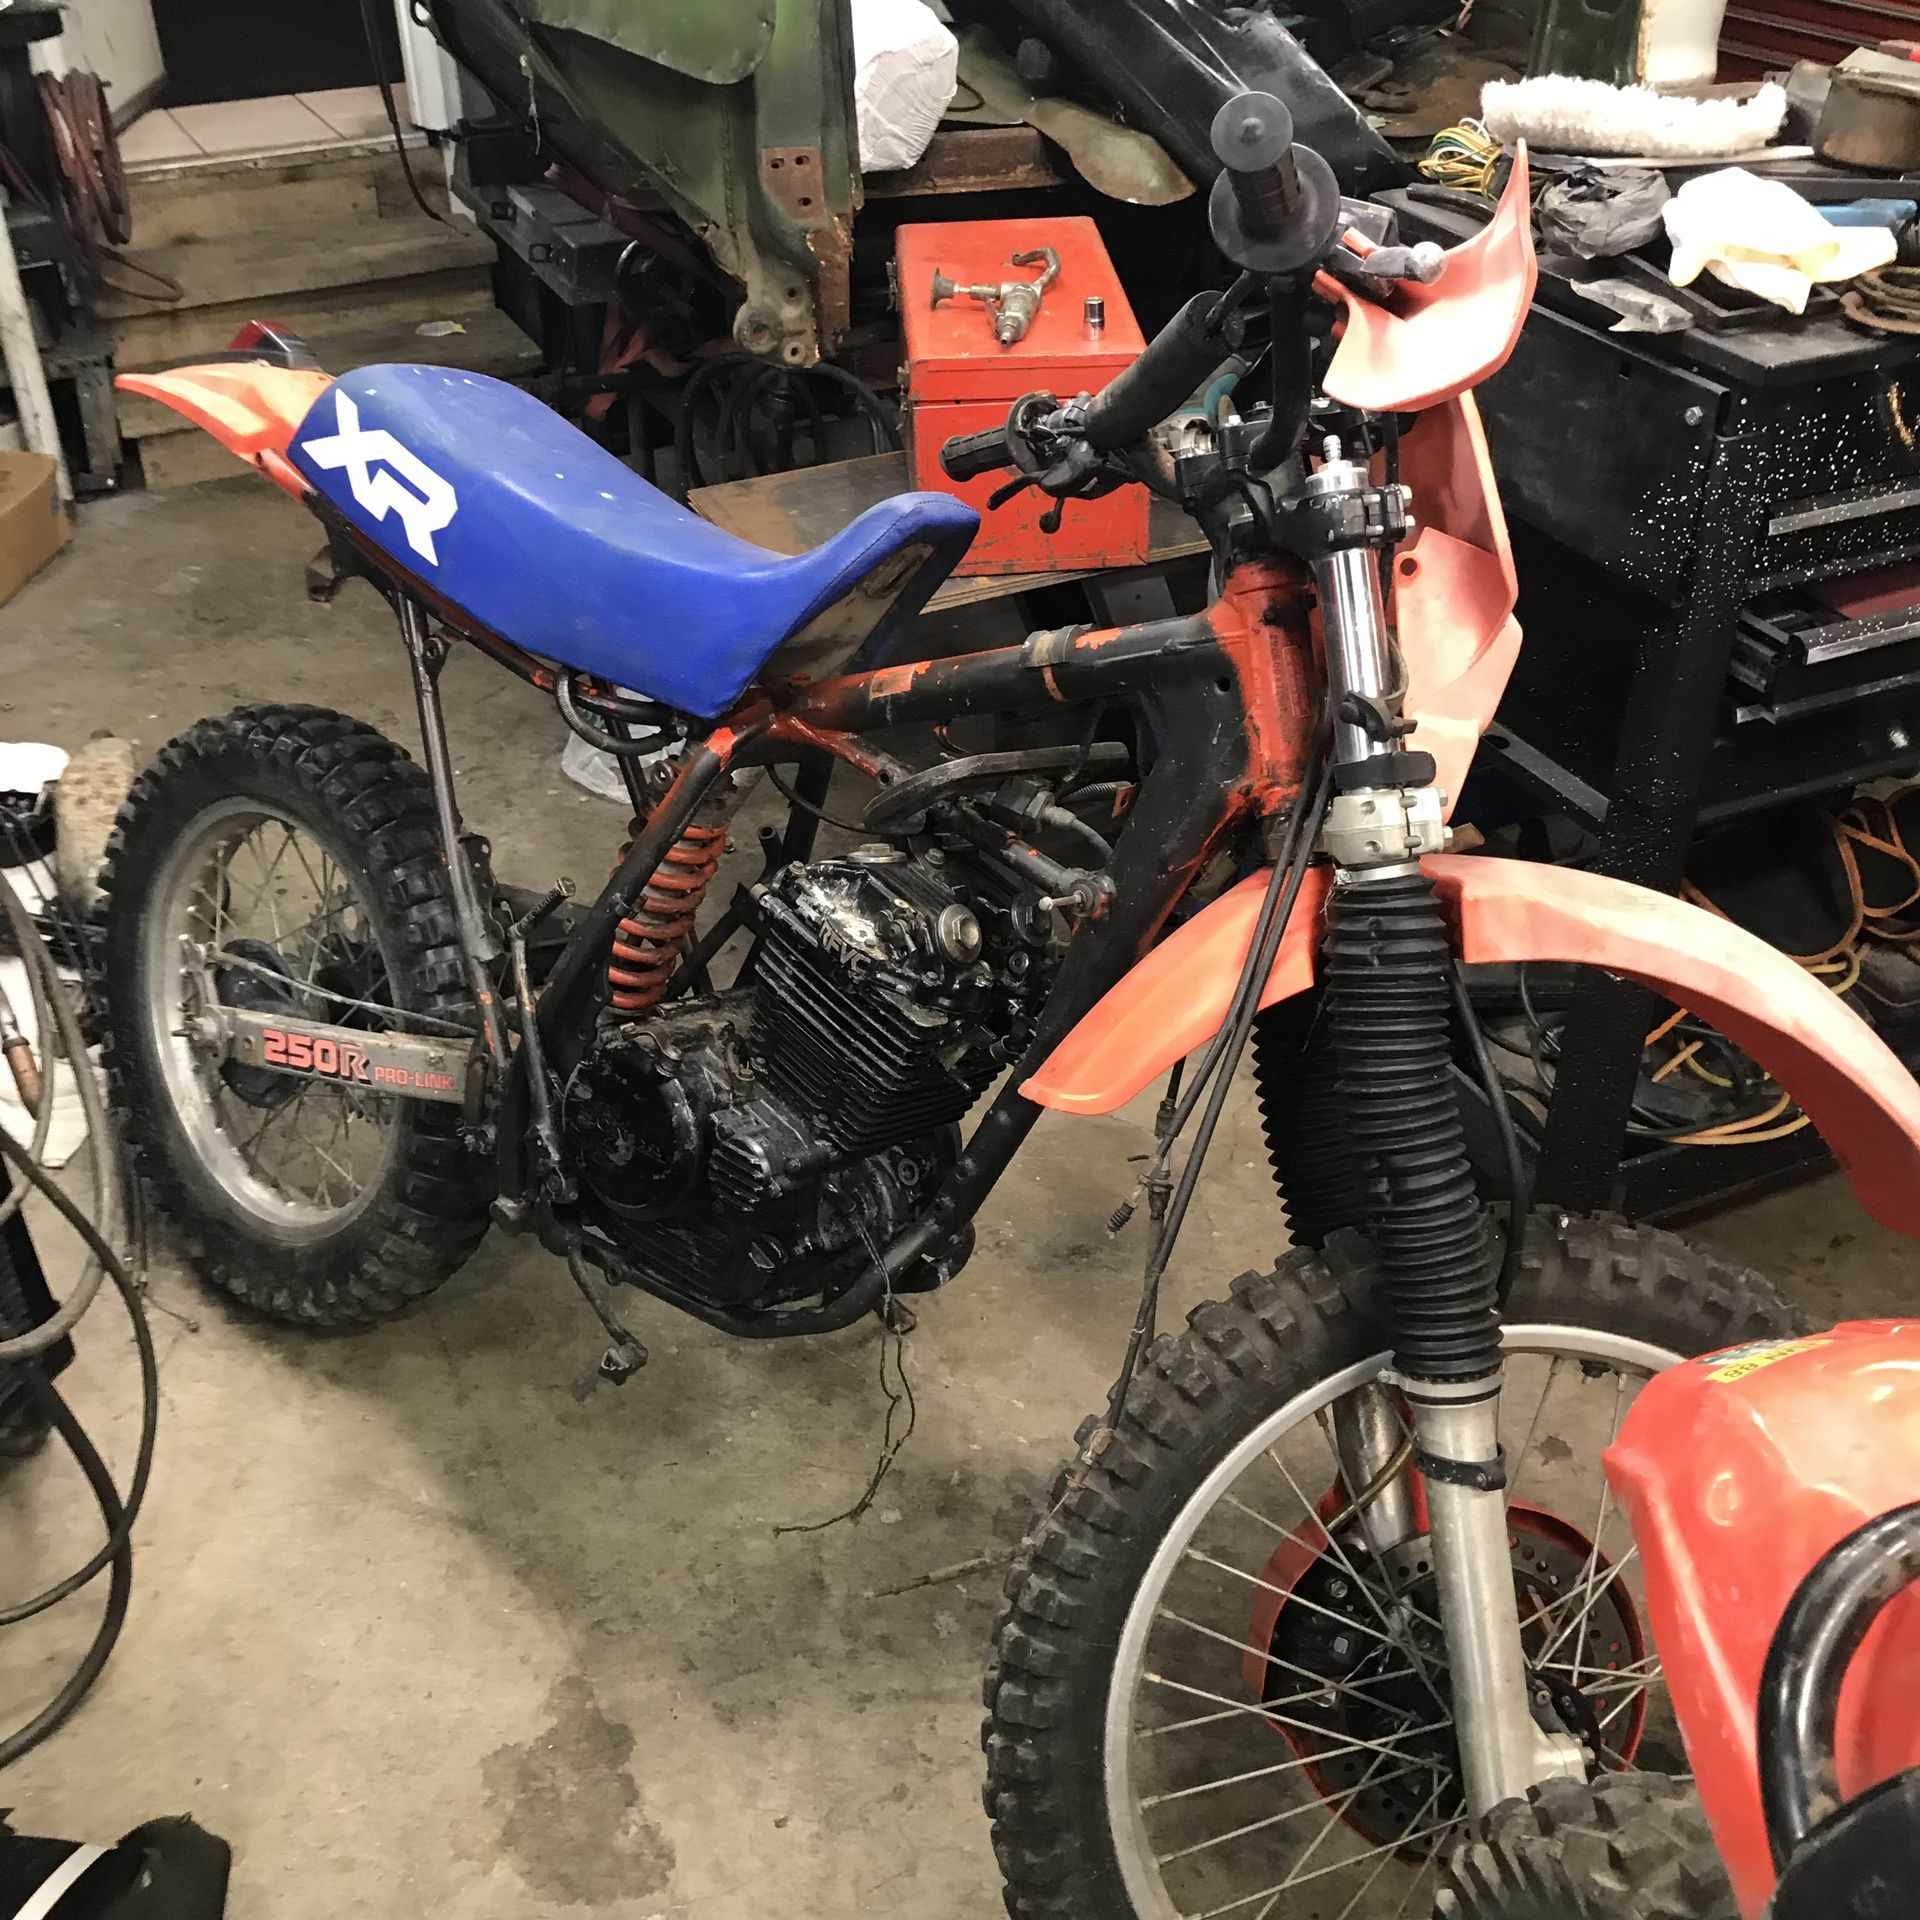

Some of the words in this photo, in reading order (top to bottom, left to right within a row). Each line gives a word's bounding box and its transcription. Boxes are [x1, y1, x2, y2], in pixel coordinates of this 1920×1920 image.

[301, 387, 459, 567] XR
[818, 916, 873, 979] RFVC
[262, 1028, 371, 1085] 250R
[374, 1065, 453, 1090] PRO-LINK
[1723, 1362, 1759, 1379] 88
